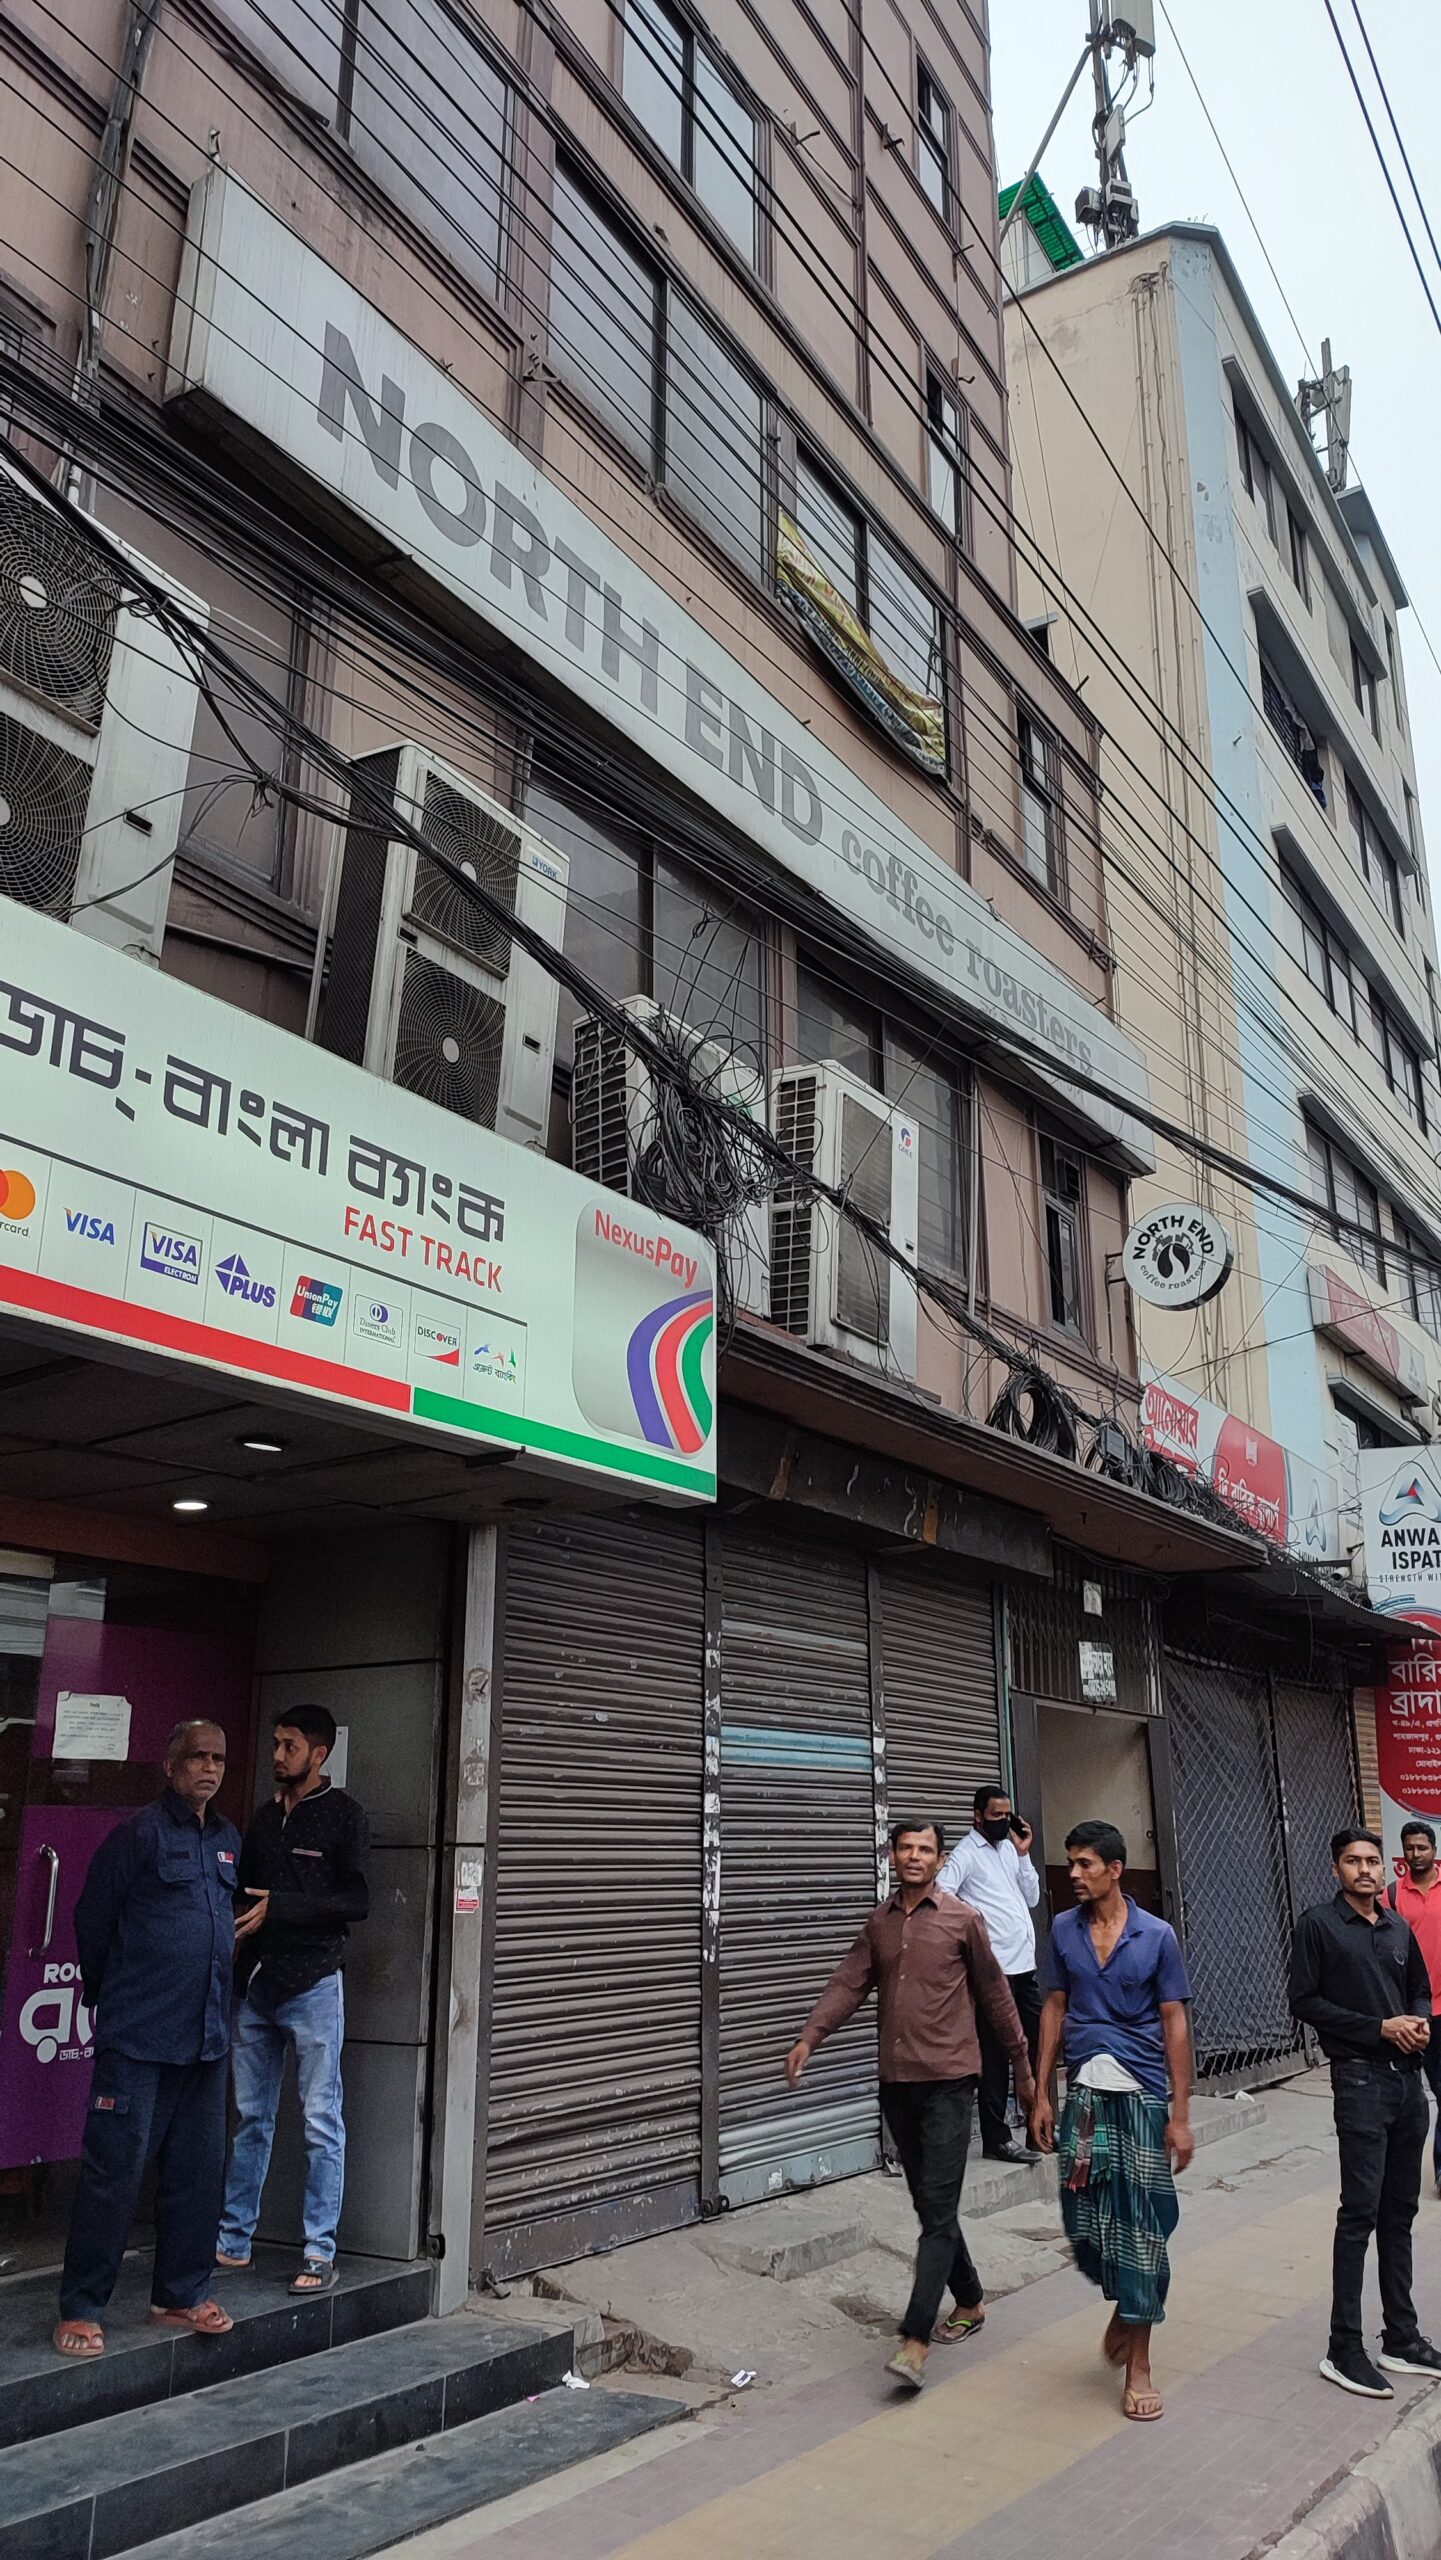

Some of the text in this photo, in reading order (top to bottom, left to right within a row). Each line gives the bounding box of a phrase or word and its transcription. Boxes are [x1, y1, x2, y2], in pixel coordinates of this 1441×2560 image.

[317, 321, 660, 716] NORTH
[684, 656, 823, 848] END
[841, 828, 954, 957] coffee
[965, 937, 1094, 1078] roasters
[348, 1134, 505, 1243] ব্যাংক
[64, 1207, 116, 1245] VISA
[1132, 1215, 1214, 1260] NORTH END
[150, 1230, 198, 1267] VISA
[344, 1206, 503, 1293] FAST TRACK
[594, 1208, 698, 1289] NexusPay
[163, 1265, 197, 1284] ELECTRON
[1140, 1260, 1207, 1290] coffee roasters
[228, 1275, 277, 1307] PLUS
[297, 1284, 339, 1312] UnionPay
[360, 1317, 396, 1336] Diners Club
[417, 1326, 458, 1347] DISCOVER
[1379, 1573, 1422, 1583] STRENGTH
[1388, 1652, 1441, 1684] বারি
